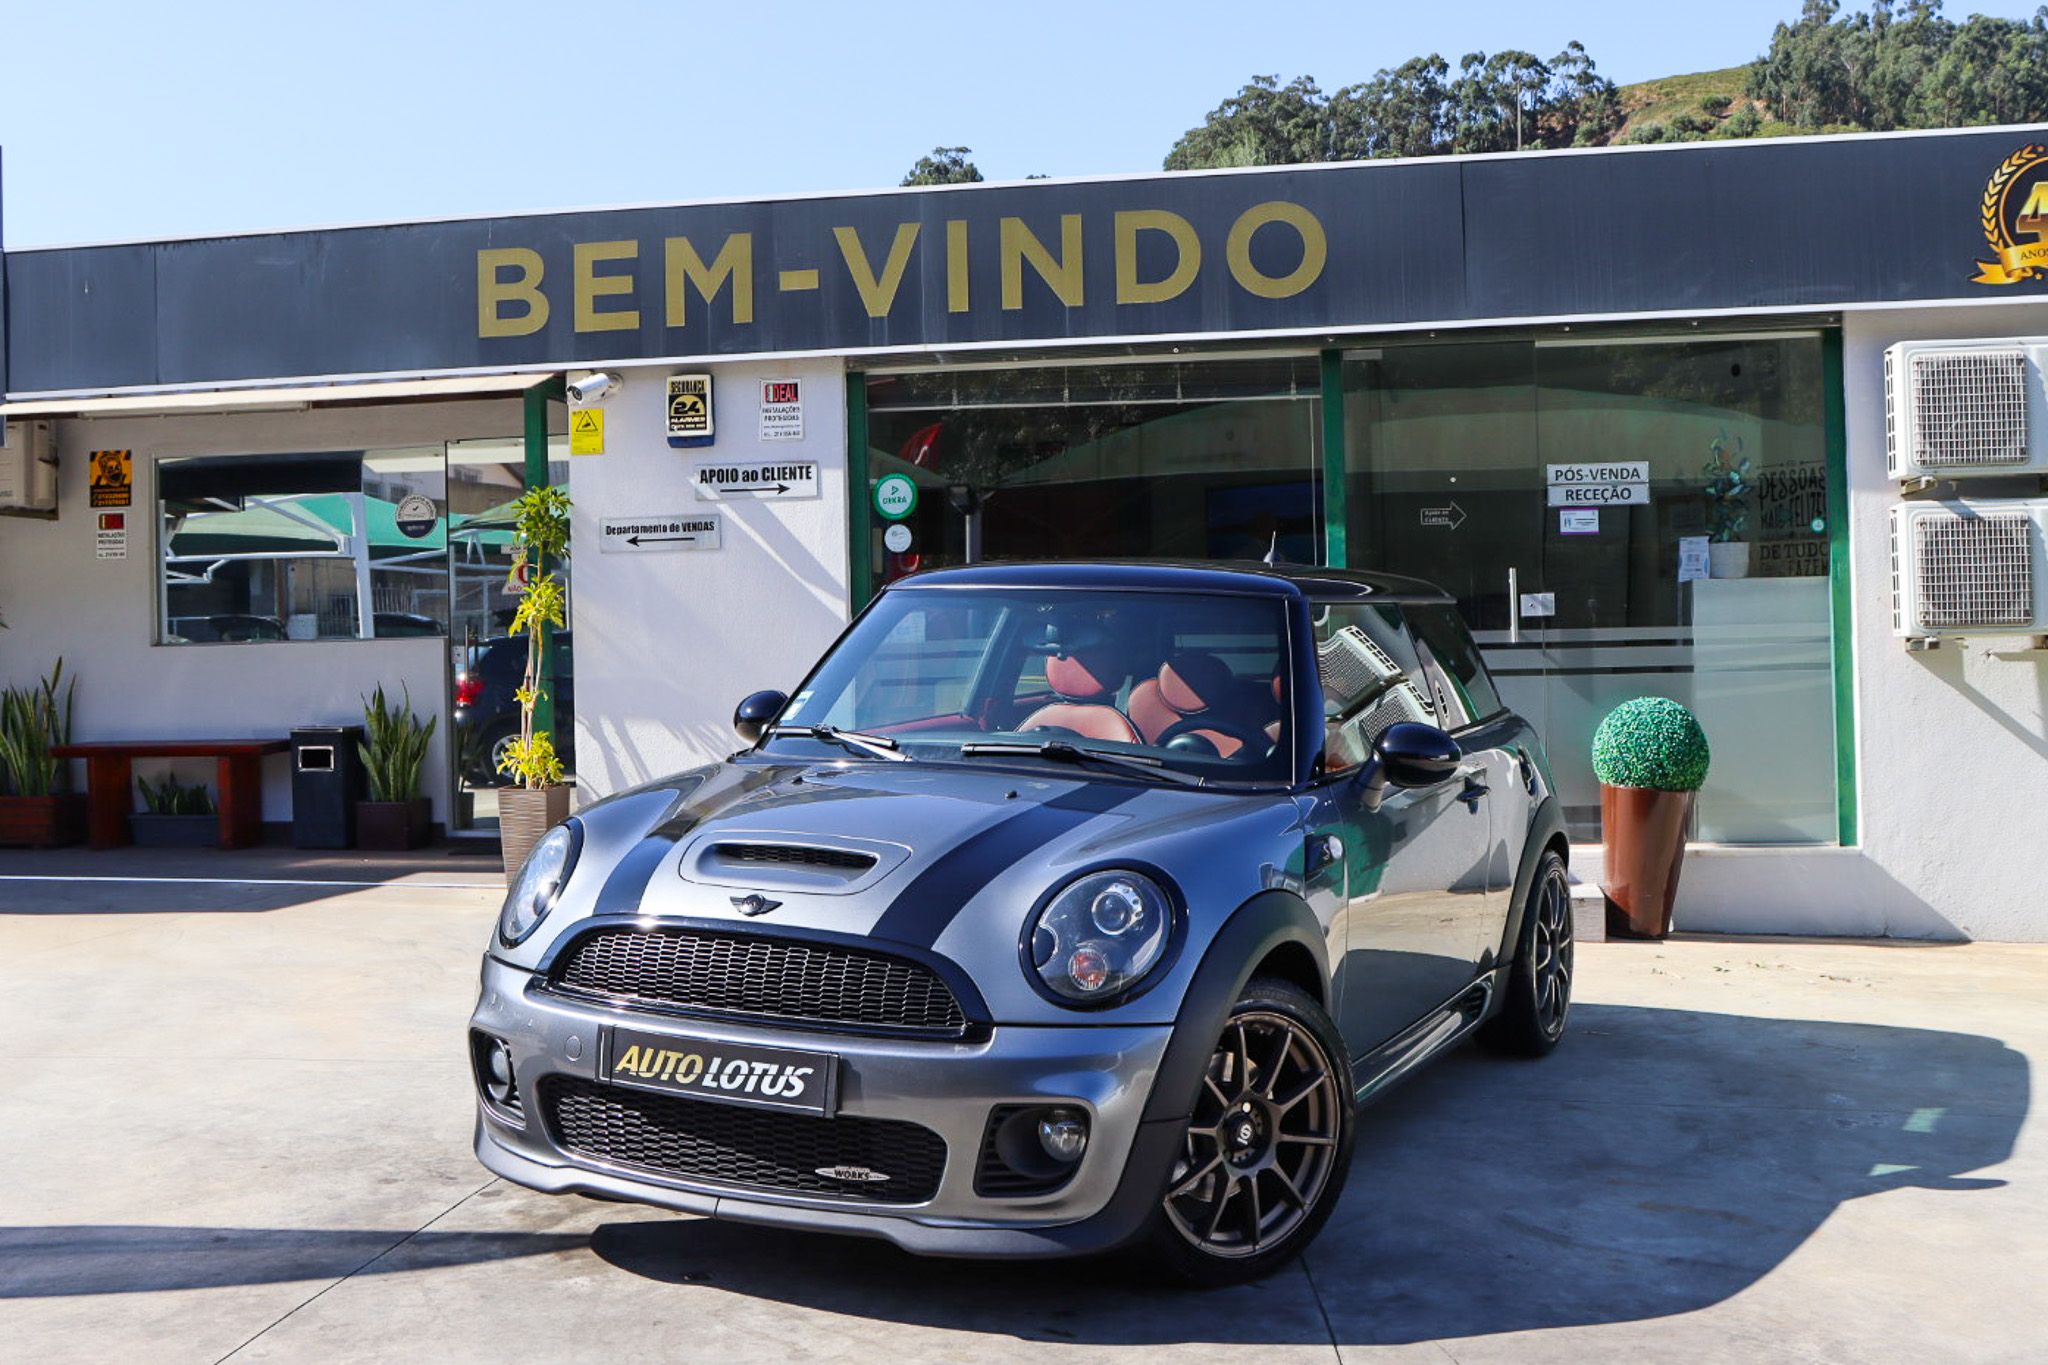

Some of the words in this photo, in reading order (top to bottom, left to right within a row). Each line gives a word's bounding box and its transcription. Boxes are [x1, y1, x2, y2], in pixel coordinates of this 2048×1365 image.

[477, 201, 1328, 338] BEM-VINDO
[674, 400, 701, 415] 24
[700, 468, 739, 484] APOIO
[742, 469, 759, 483] ao
[761, 465, 812, 482] CLIENTE
[1555, 466, 1641, 482] PÓS-VENDA
[1566, 485, 1632, 503] RECEÇÃO
[605, 524, 668, 536] Departamento
[669, 523, 680, 533] de
[681, 520, 715, 533] VENDAS
[834, 1169, 870, 1181] WORKS
